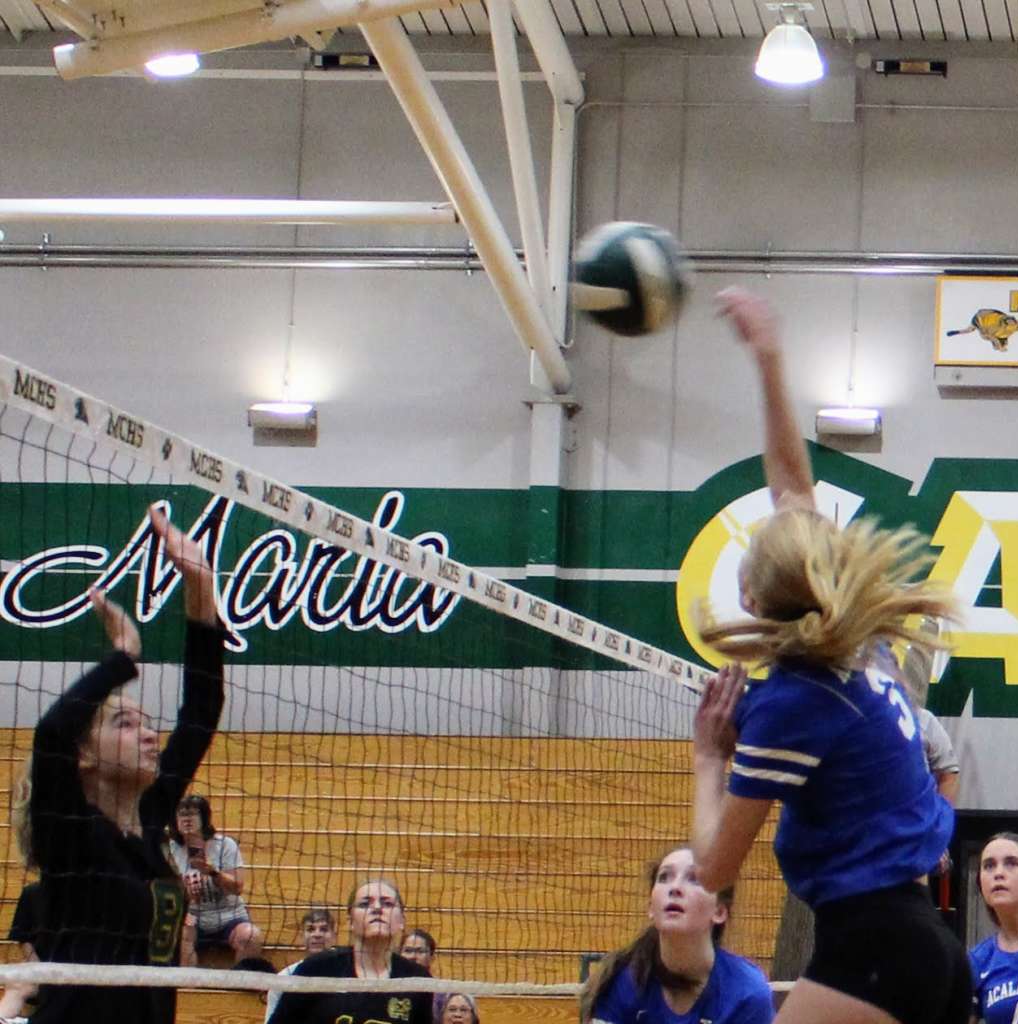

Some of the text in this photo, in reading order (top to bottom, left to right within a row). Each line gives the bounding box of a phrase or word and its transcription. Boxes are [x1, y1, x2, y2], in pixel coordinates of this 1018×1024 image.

[14, 368, 57, 410] MCHS
[107, 410, 145, 449] MCHS
[0, 489, 462, 652] Maria
[864, 666, 916, 741] 3
